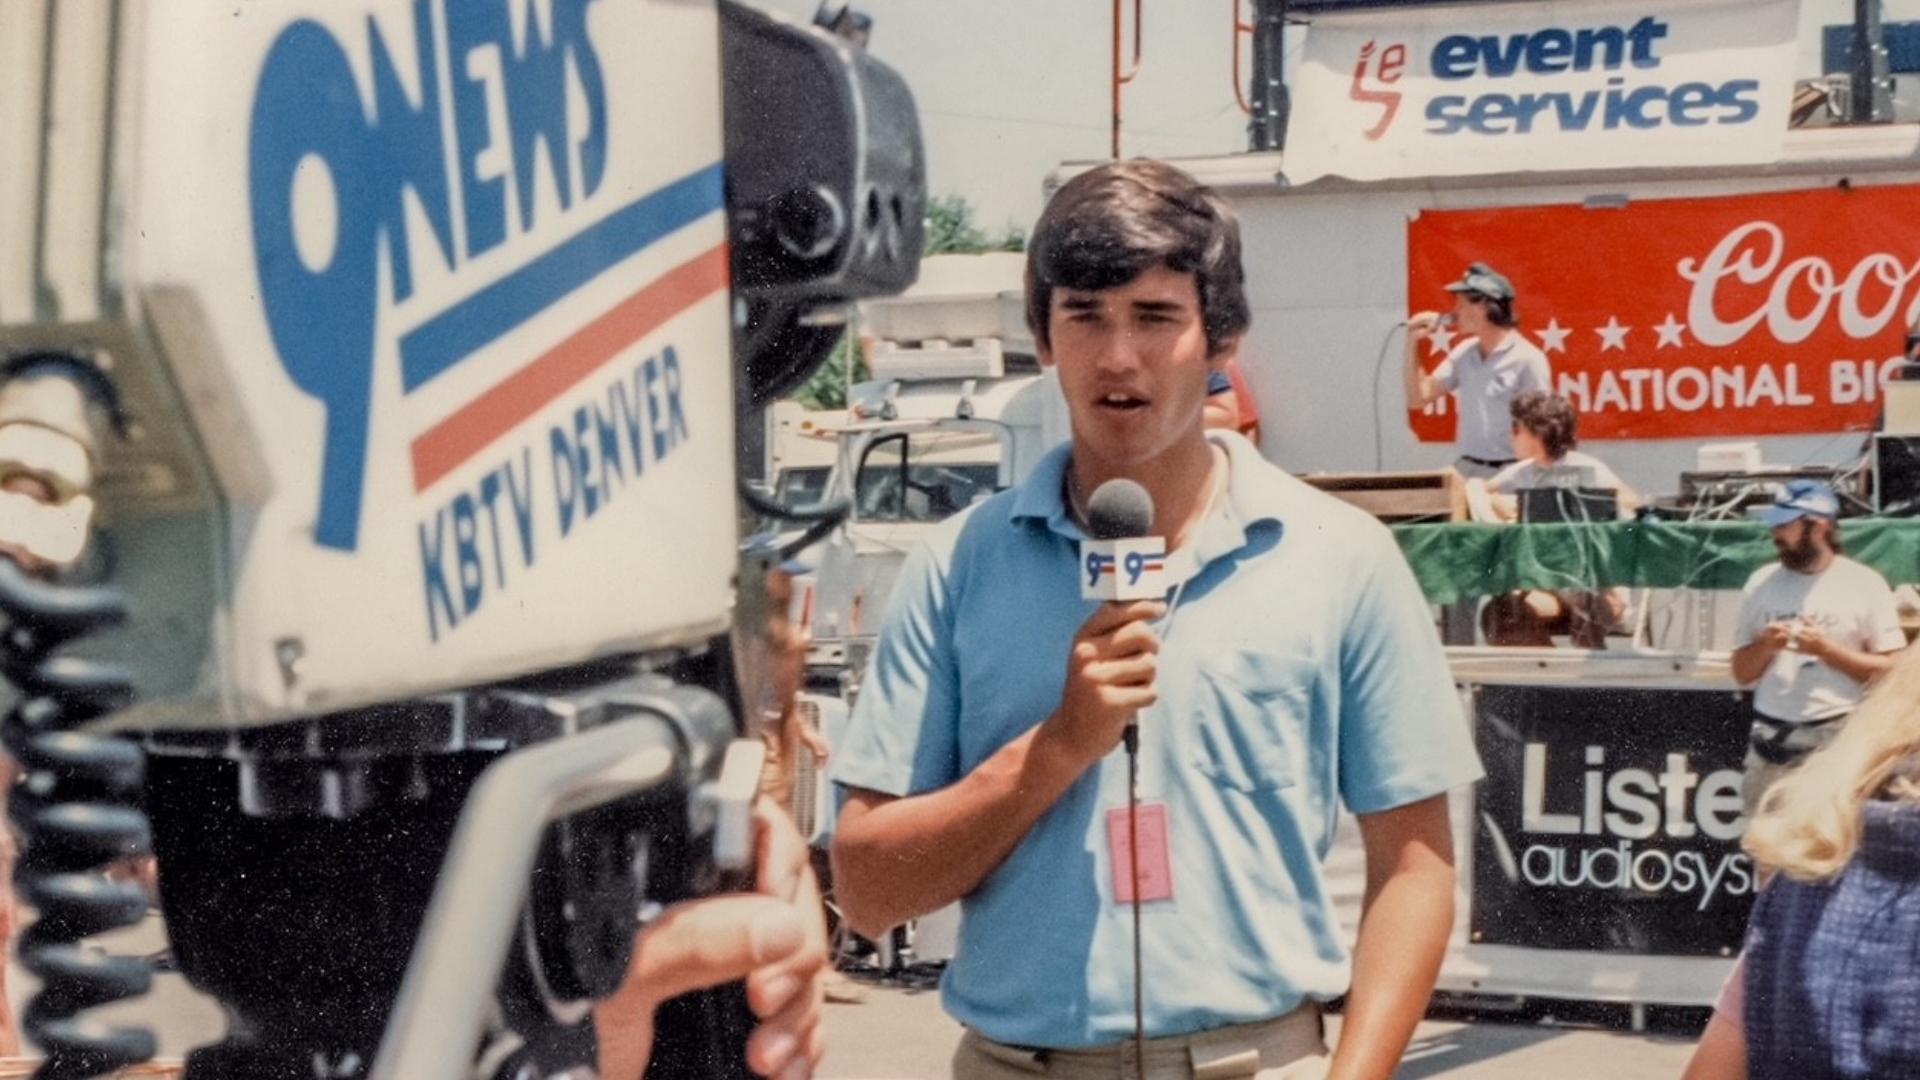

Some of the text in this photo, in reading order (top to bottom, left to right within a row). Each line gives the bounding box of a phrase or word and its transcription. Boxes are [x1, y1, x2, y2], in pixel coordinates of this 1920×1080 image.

[1430, 16, 1667, 81] event
[1423, 76, 1759, 135] services
[1677, 220, 1920, 347] Coo
[1423, 363, 1813, 416] NATIONAL
[417, 346, 689, 643] KBTV DENVER
[1086, 551, 1102, 587] 9
[1124, 551, 1144, 586] 9
[1522, 742, 1745, 841] Liste
